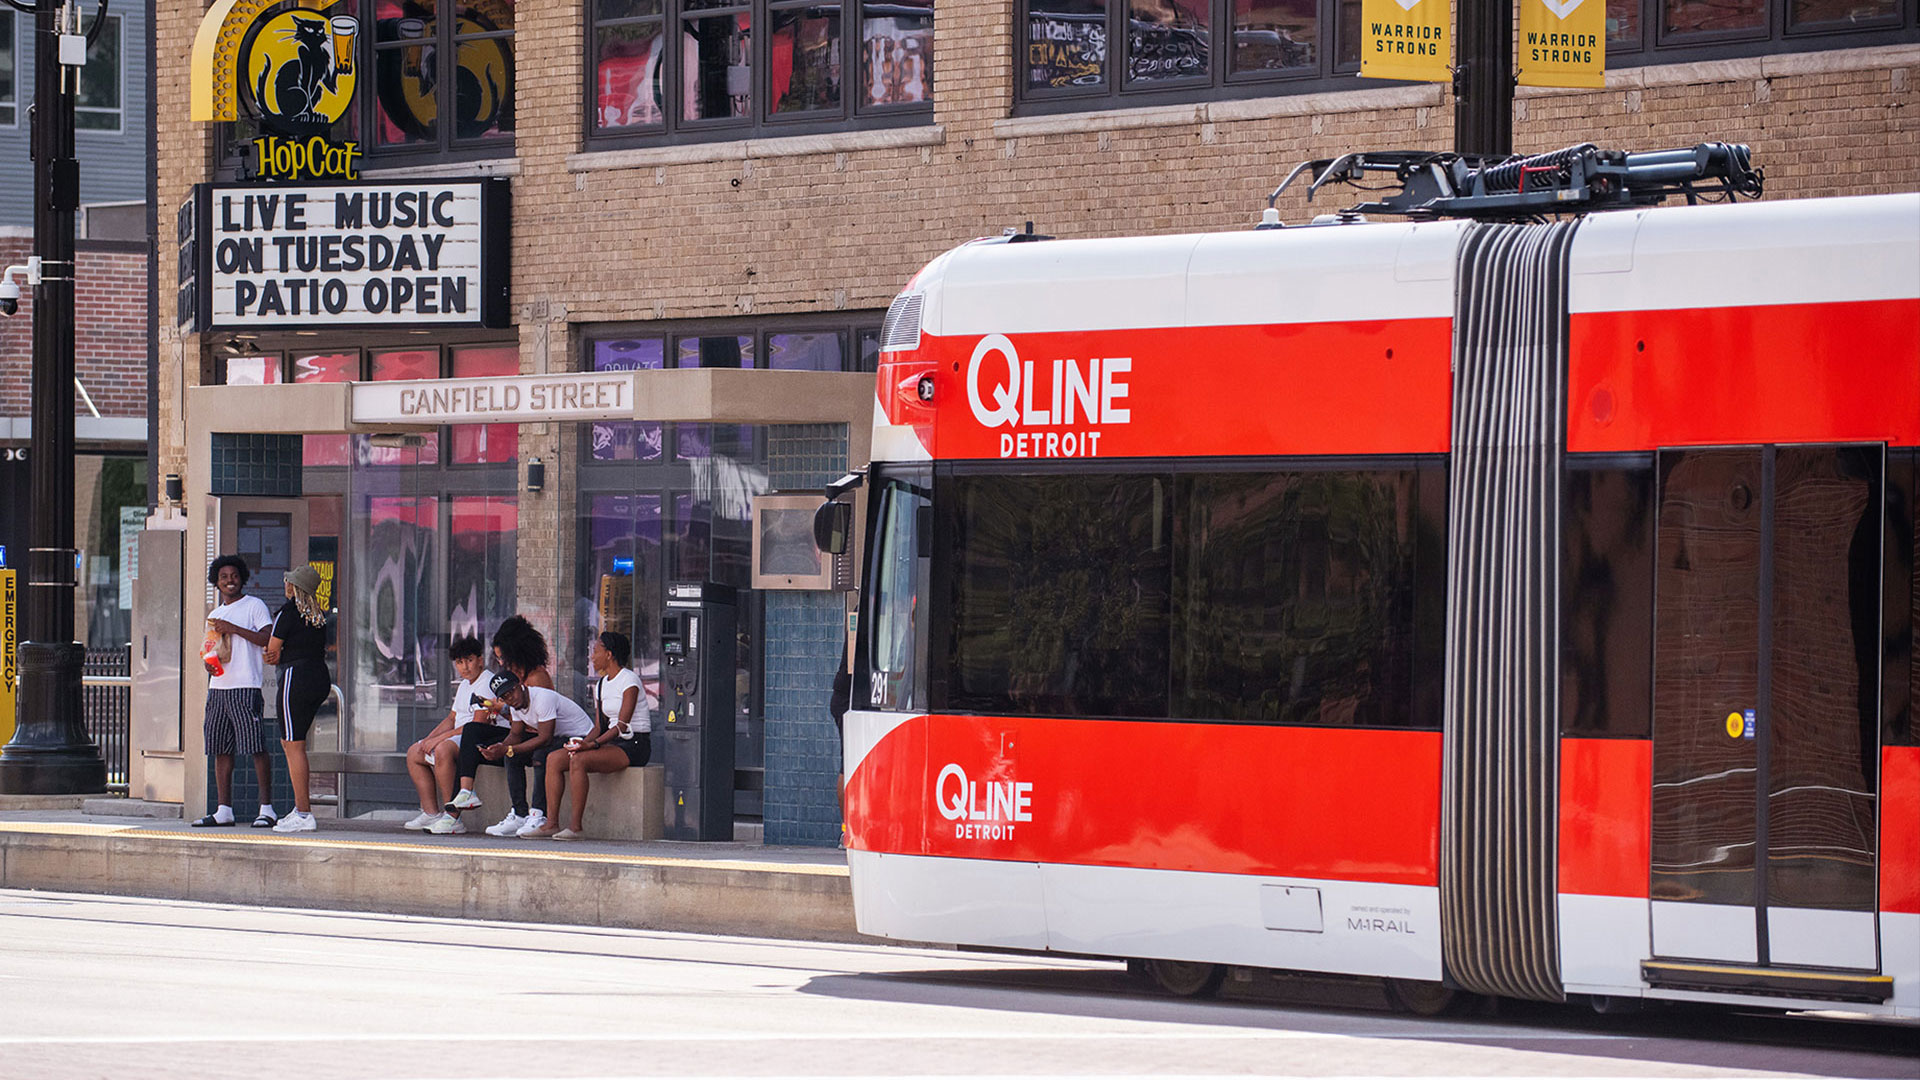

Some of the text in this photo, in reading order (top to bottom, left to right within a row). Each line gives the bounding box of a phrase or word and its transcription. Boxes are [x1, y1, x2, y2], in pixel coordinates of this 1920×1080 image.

[1371, 23, 1442, 40] WARRIOR
[1376, 40, 1437, 56] STRONG
[1527, 32, 1597, 48] WARRIOR
[1532, 48, 1592, 63] STRONG
[253, 135, 363, 181] HopCat
[222, 194, 307, 232] LIVE
[335, 191, 454, 230] MUSIC
[216, 237, 264, 274] ON
[272, 234, 446, 273] TUESDAY
[235, 278, 348, 316] PATIO
[363, 276, 467, 315] OPEN
[400, 380, 627, 415] CANFIELD STREET
[966, 333, 1132, 428] QLINE
[1000, 431, 1102, 458] DETROIT
[5, 577, 15, 693] EMERGENCY
[871, 671, 888, 705] 291
[936, 763, 1033, 822] QLINE
[956, 823, 1015, 841] DETROIT
